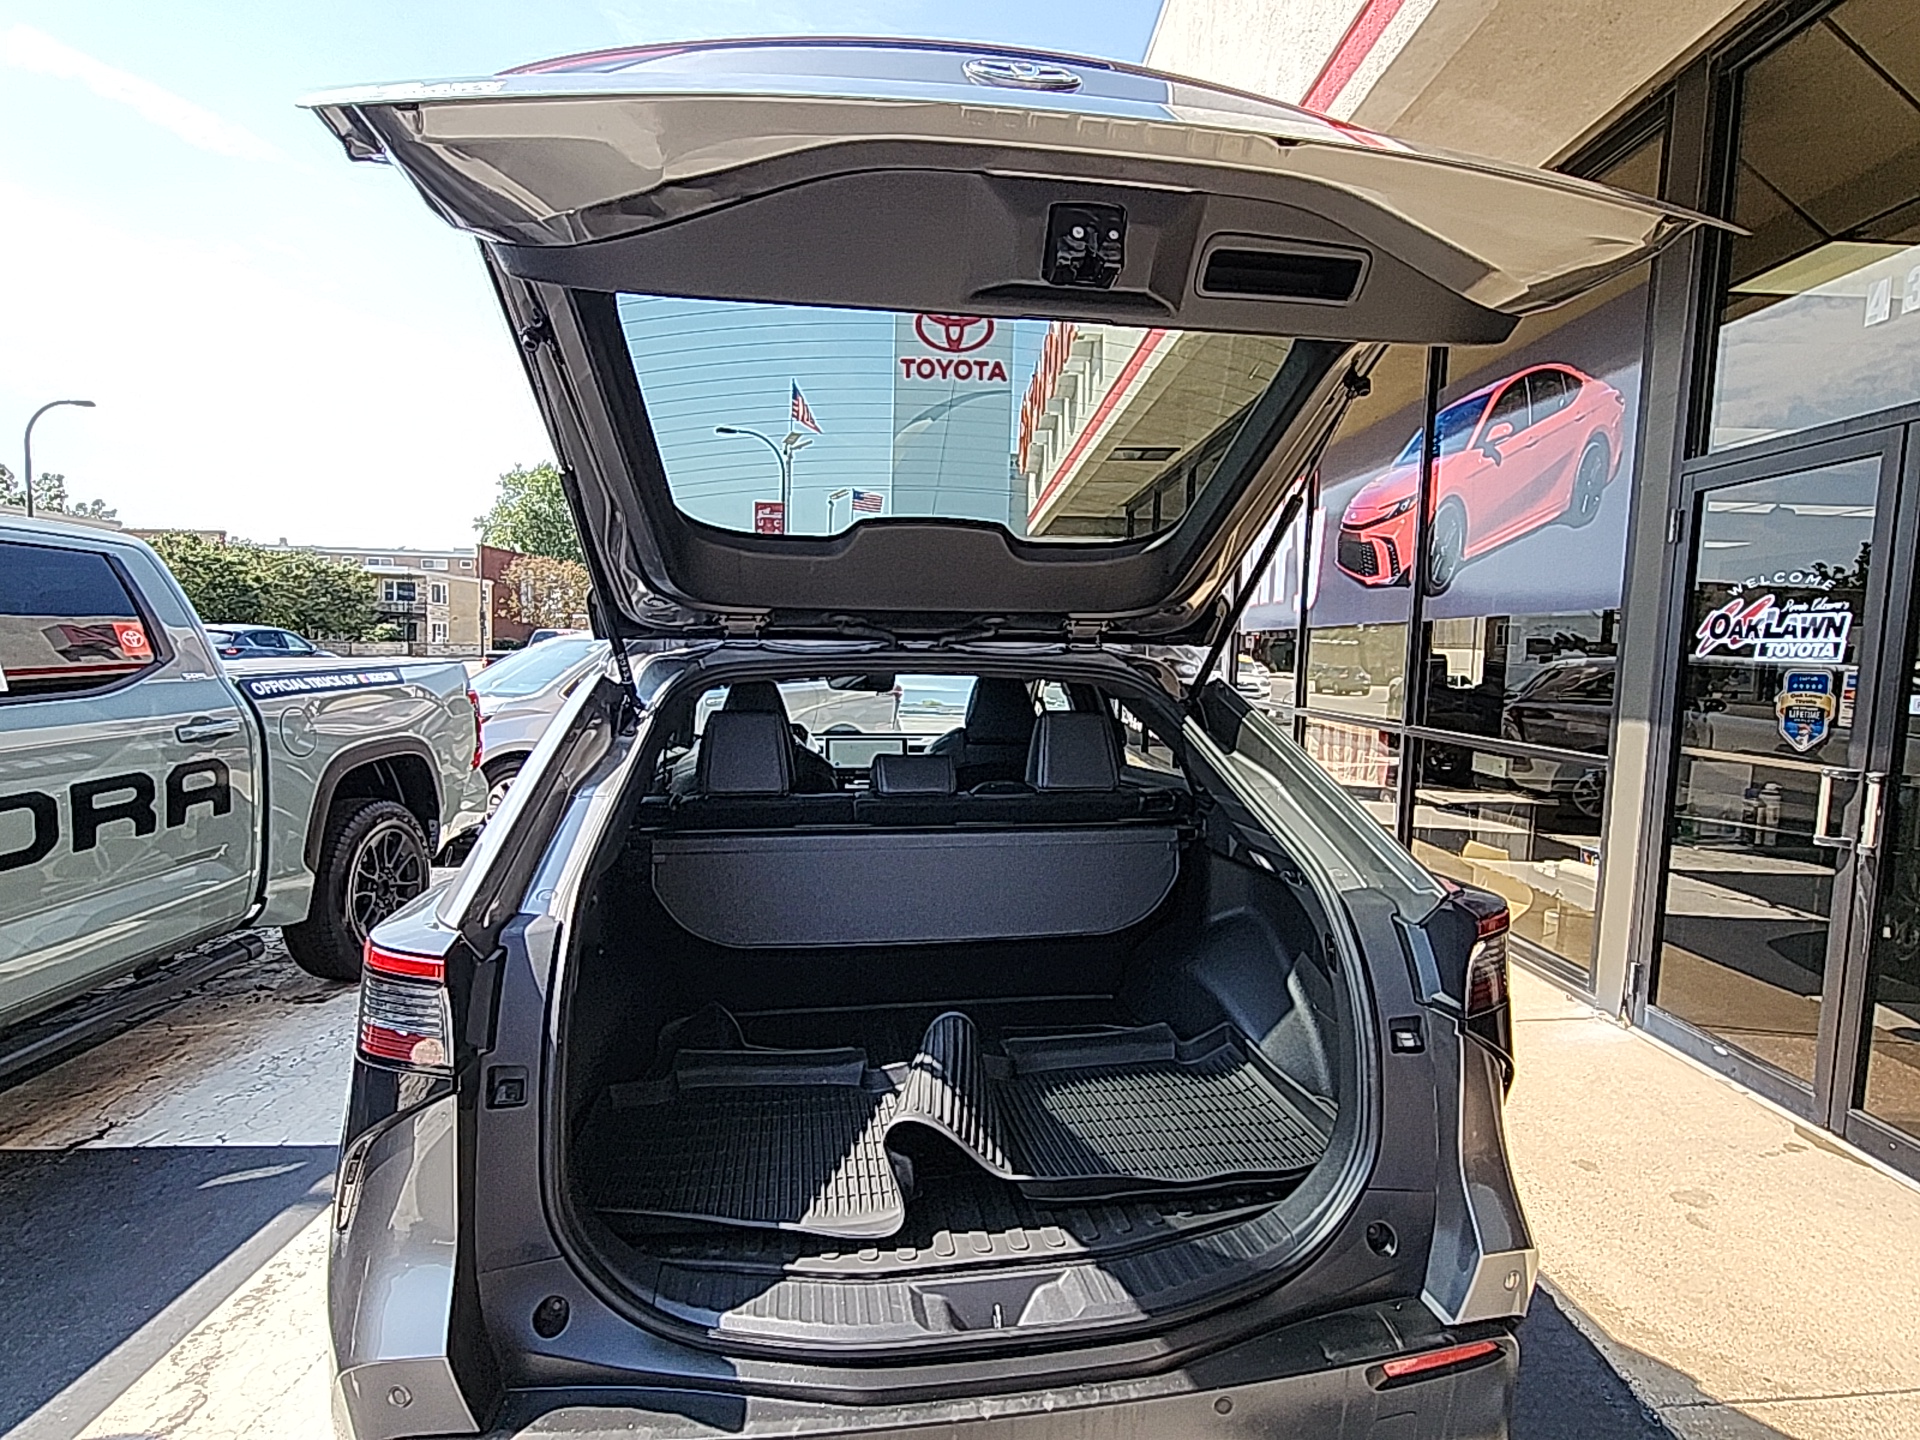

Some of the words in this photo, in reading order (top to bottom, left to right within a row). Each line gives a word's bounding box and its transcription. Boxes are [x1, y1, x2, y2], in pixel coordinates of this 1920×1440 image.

[900, 359, 1007, 382] TOYOTA
[1727, 572, 1836, 596] WELCOME
[1764, 643, 1835, 658] TOYOTA
[250, 678, 311, 696] OFFICIAL
[304, 675, 347, 690] TRUCK
[341, 674, 359, 684] OF
[0, 758, 231, 872] DRA
